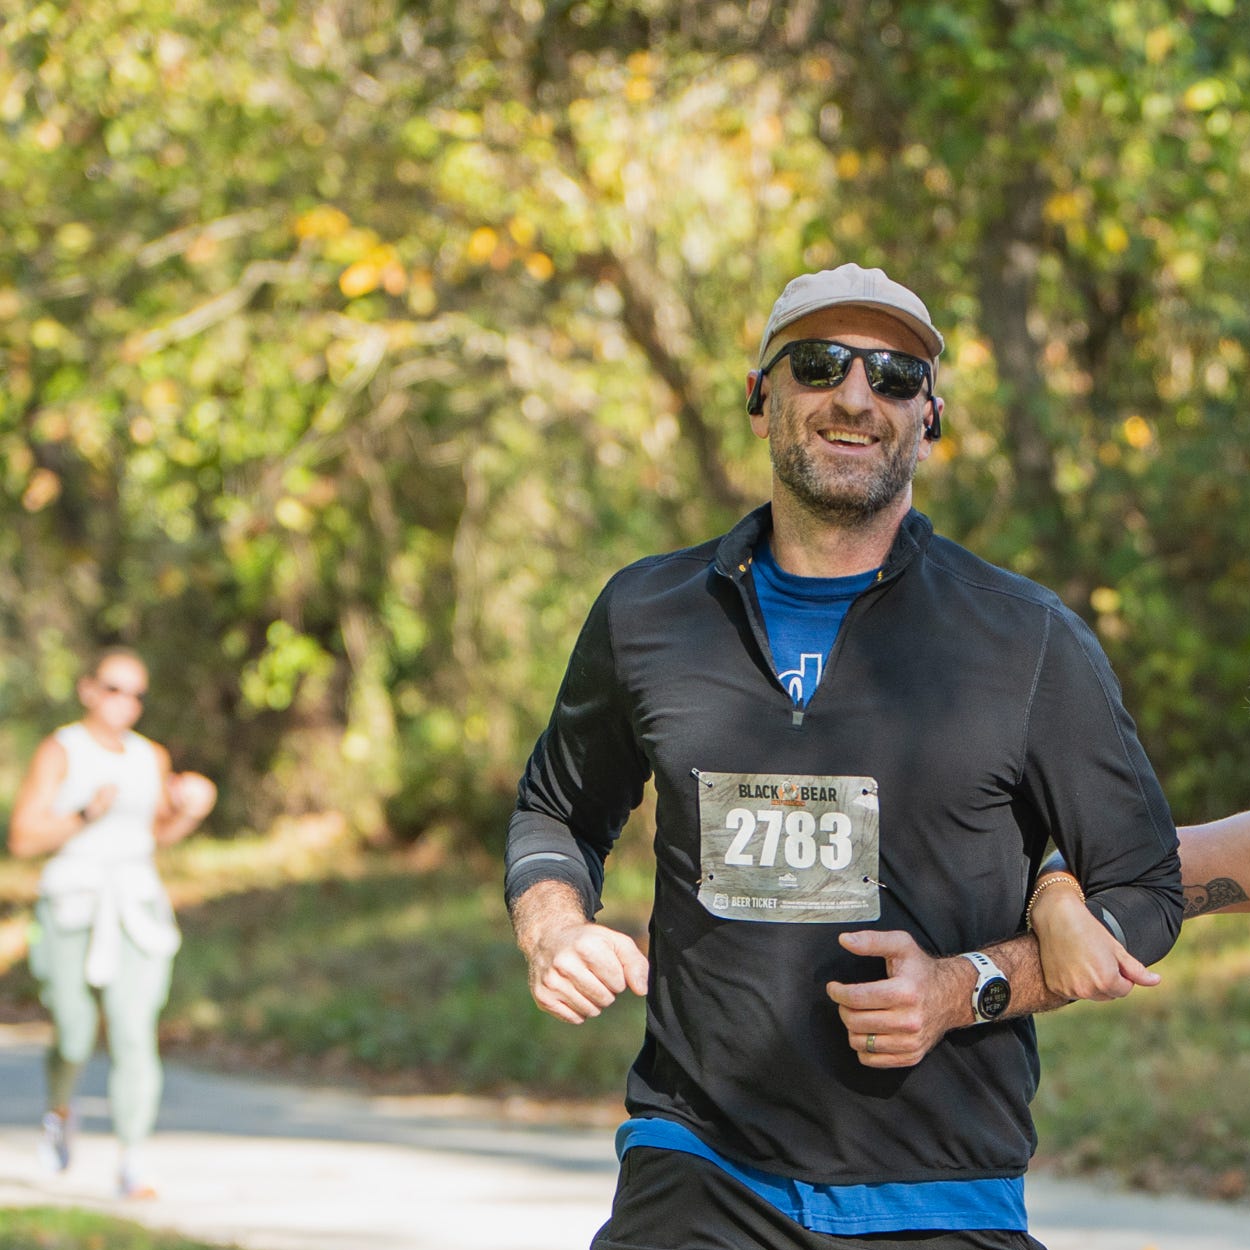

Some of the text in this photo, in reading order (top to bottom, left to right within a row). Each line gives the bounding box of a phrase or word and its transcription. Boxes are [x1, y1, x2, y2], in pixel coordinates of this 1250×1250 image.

[738, 784, 837, 802] BLACK BEAR
[724, 808, 853, 870] 2783
[731, 896, 750, 908] BEER
[752, 897, 778, 909] TICKET
